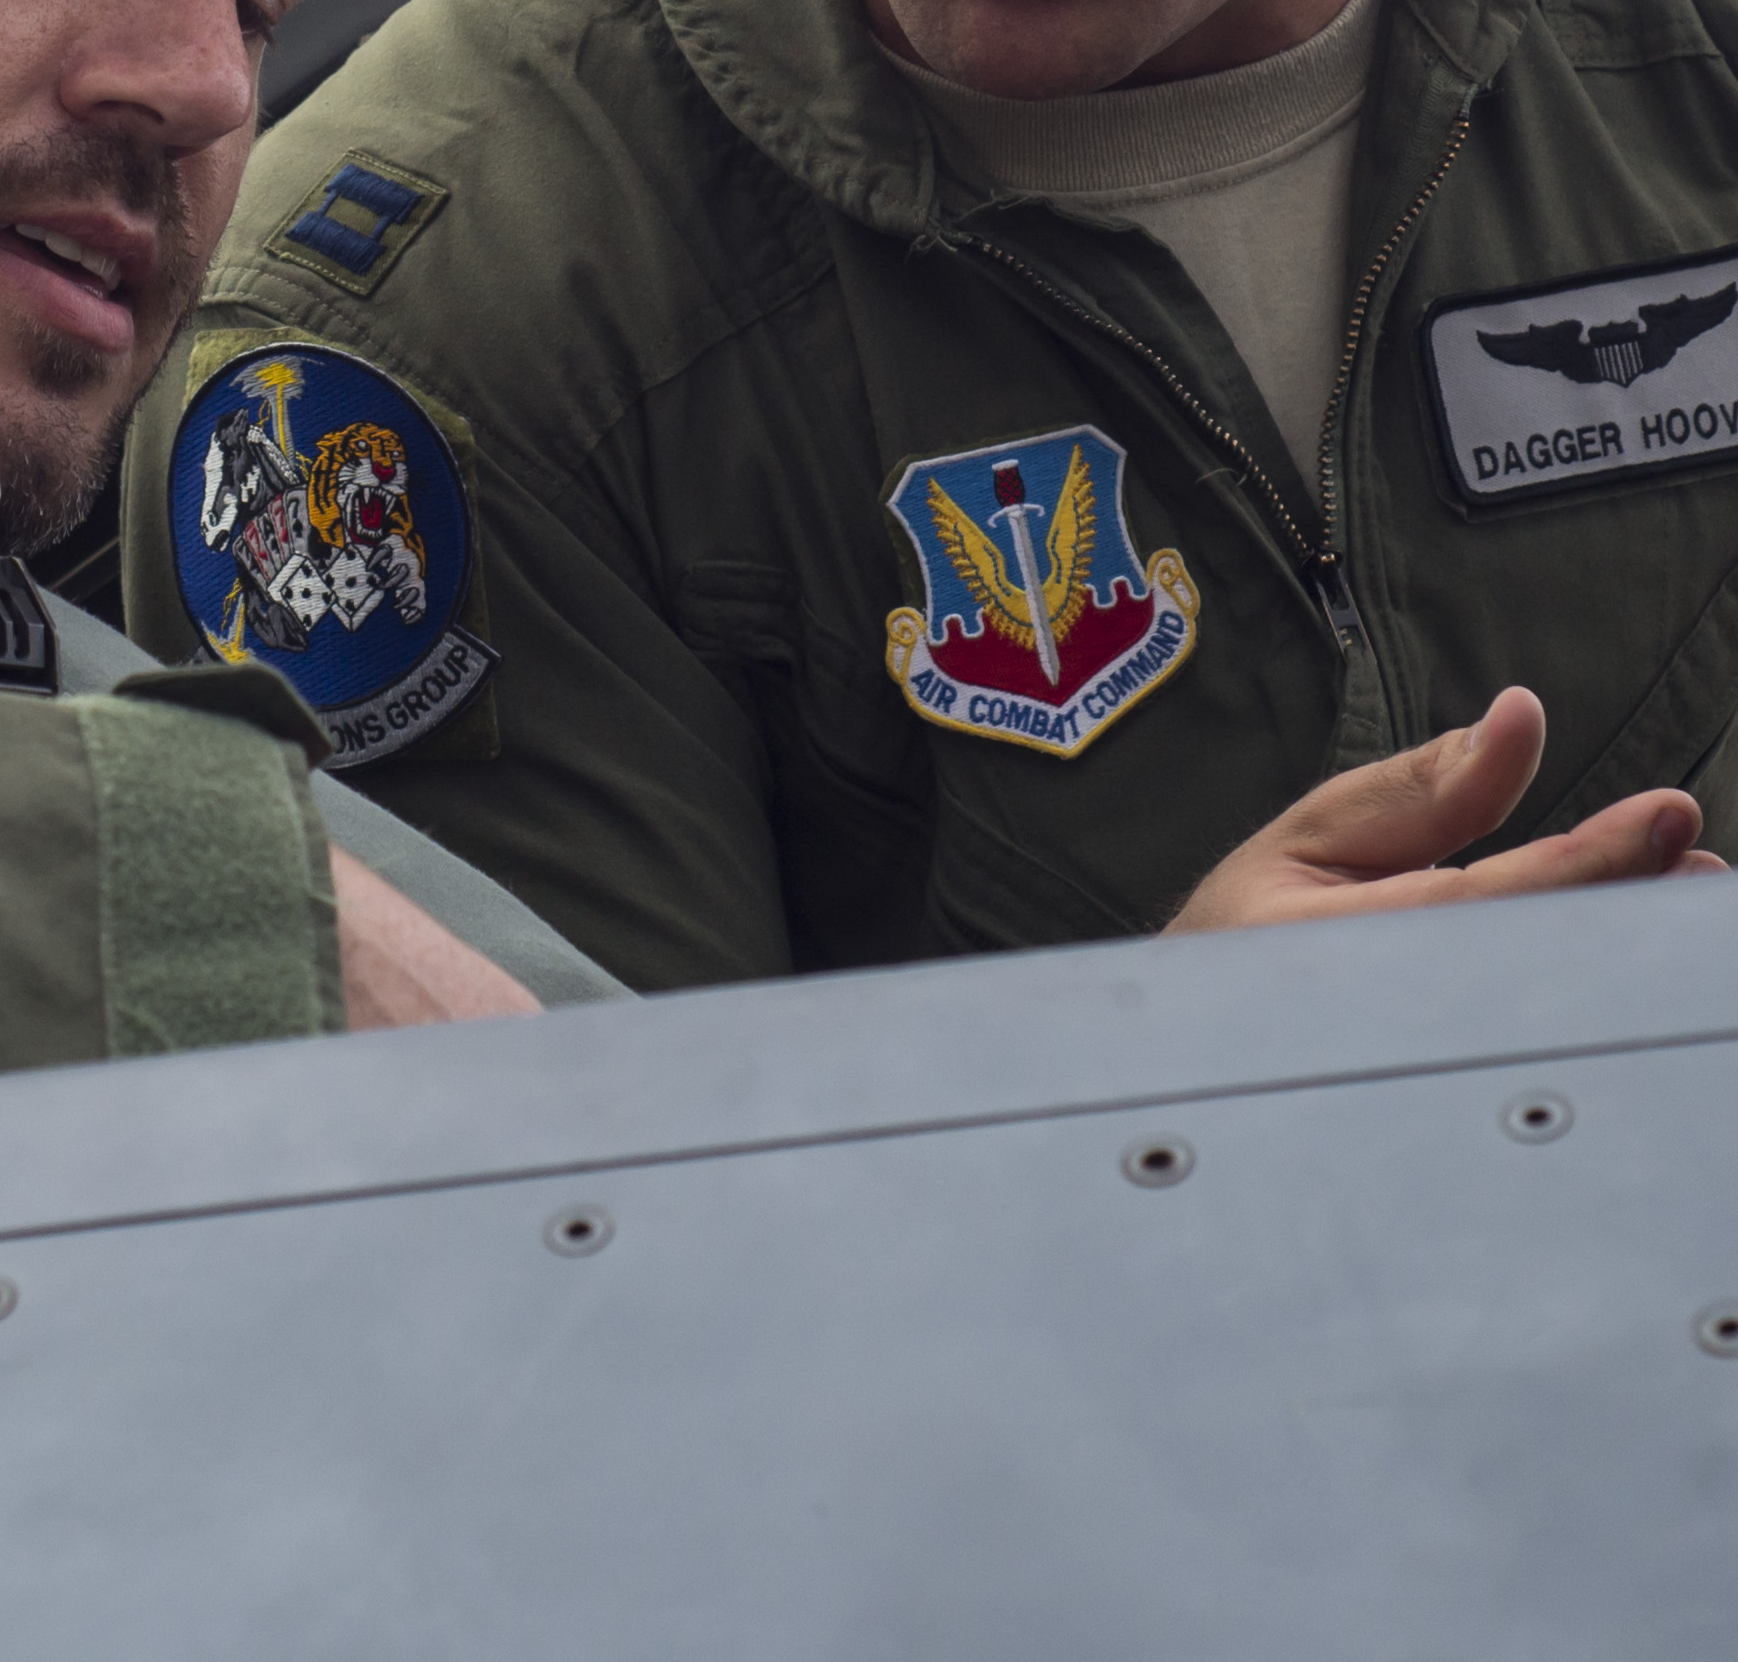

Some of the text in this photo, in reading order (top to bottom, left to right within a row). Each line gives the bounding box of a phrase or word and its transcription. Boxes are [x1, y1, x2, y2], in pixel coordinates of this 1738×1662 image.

[1473, 421, 1624, 481] DAGGER
[385, 644, 470, 730] GROUP
[910, 610, 1186, 744] AIR COMBAT COMMAND
